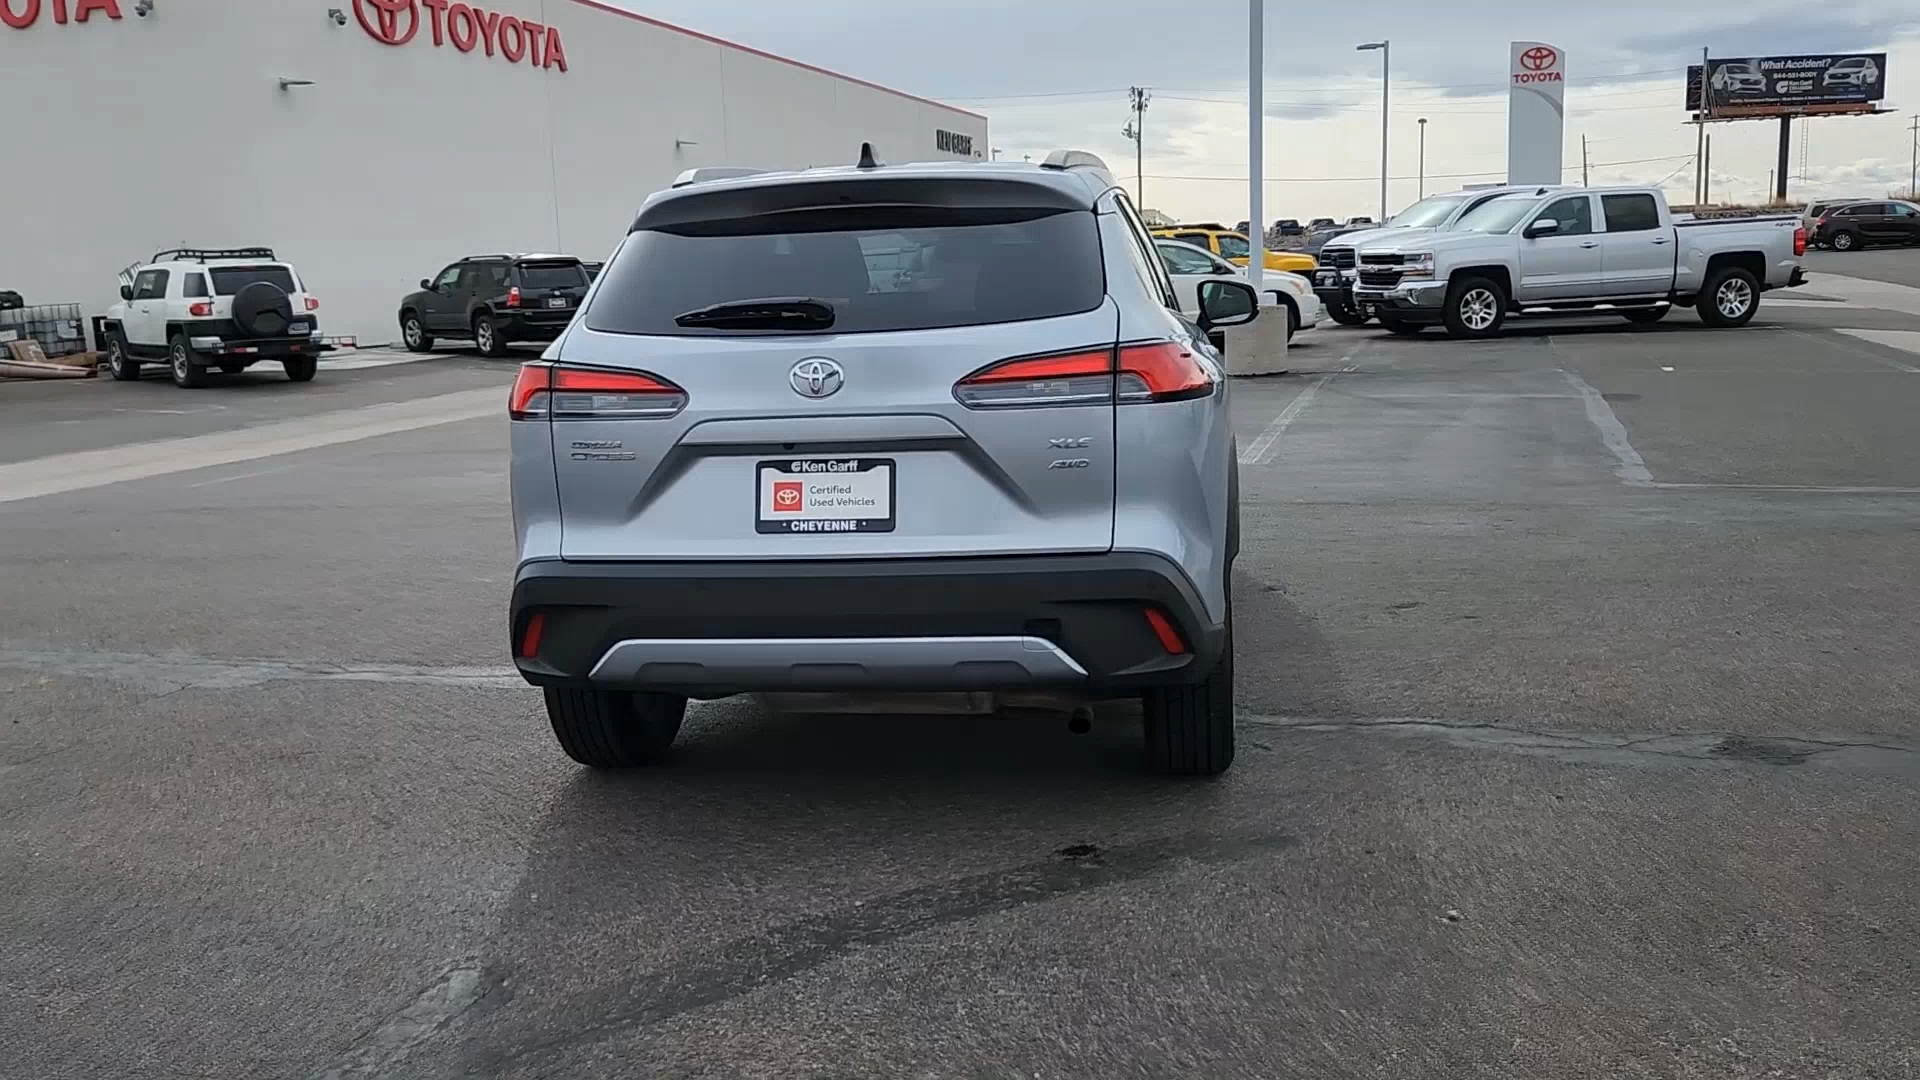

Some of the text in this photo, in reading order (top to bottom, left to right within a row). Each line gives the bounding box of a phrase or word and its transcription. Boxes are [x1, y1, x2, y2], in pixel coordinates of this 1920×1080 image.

[422, 0, 568, 73] TOYOTA
[1760, 58, 1832, 70] What Accident?
[1513, 72, 1562, 83] TOYOTA
[1047, 436, 1093, 449] XLE
[802, 461, 826, 472] Ken
[827, 460, 859, 472] Garff
[1047, 458, 1090, 470] AWD
[810, 485, 851, 494] Certified
[810, 498, 876, 507] Used Vehicles
[791, 520, 857, 532] CHEYENNE
